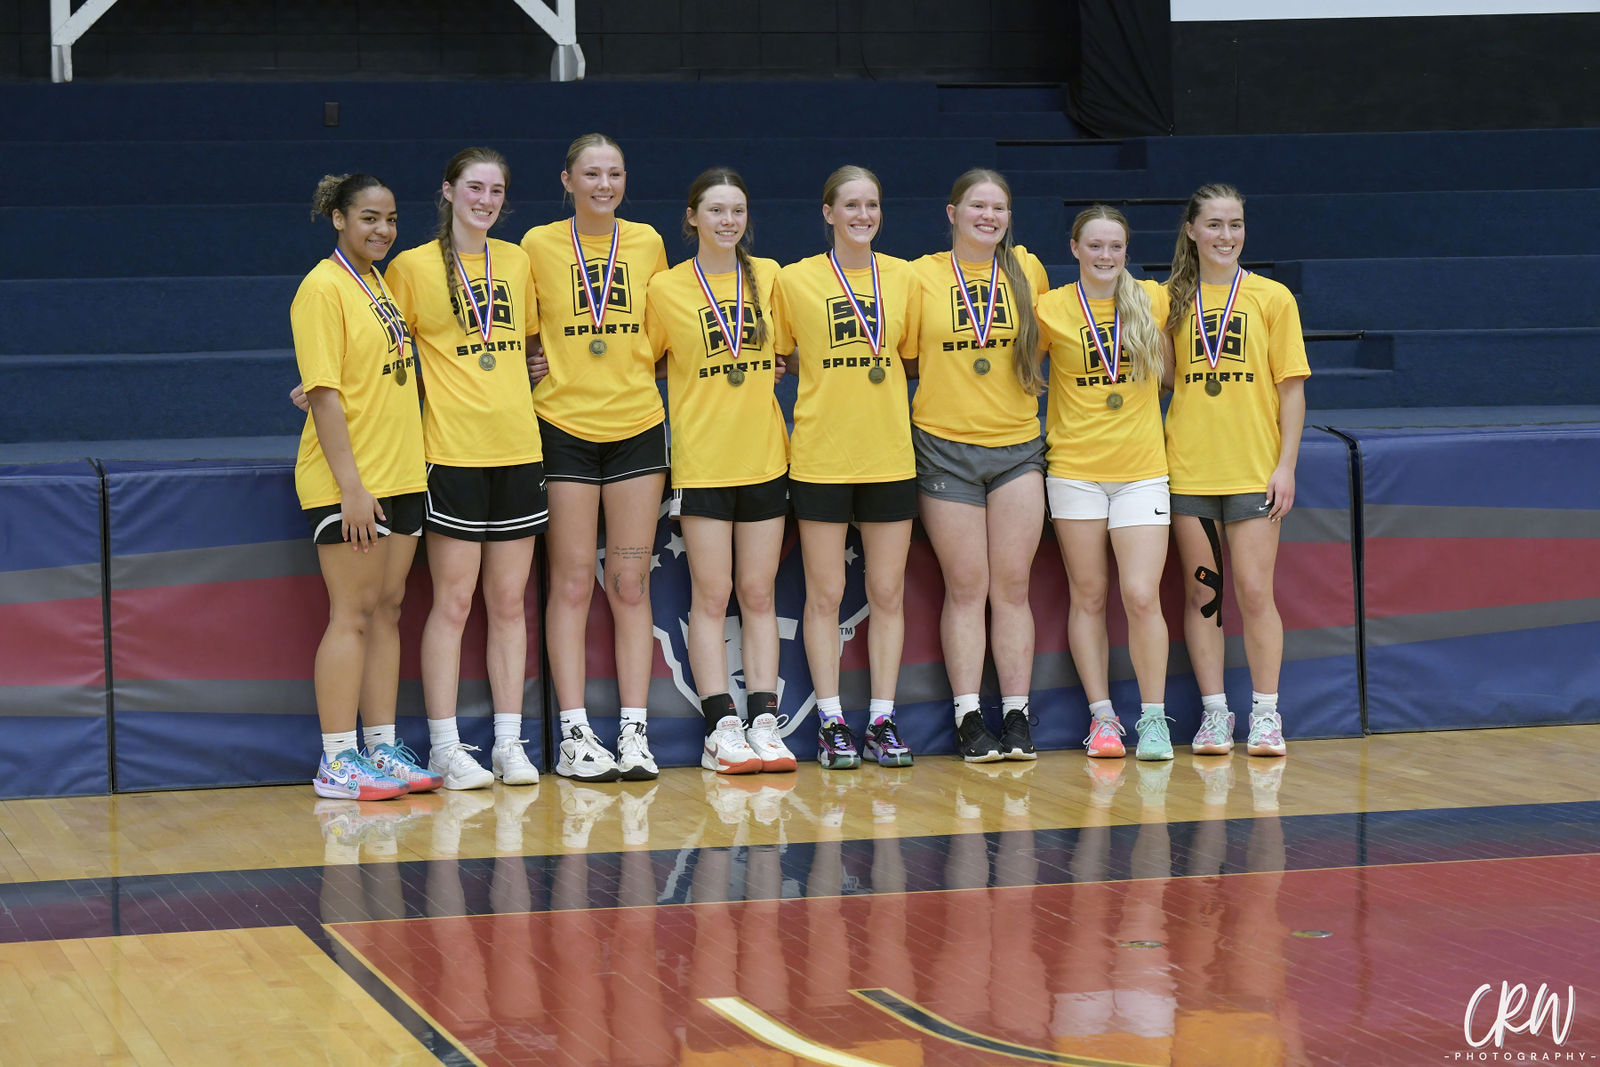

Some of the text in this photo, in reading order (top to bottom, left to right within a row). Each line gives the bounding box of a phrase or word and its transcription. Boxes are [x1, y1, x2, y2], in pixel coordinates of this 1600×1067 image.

[563, 323, 640, 336] SPORTS
[699, 360, 771, 378] SPORTS
[823, 357, 891, 369] SPORTS
[1076, 374, 1135, 386] SPOR
[1185, 372, 1254, 384] SPORTS
[839, 627, 853, 635] TM
